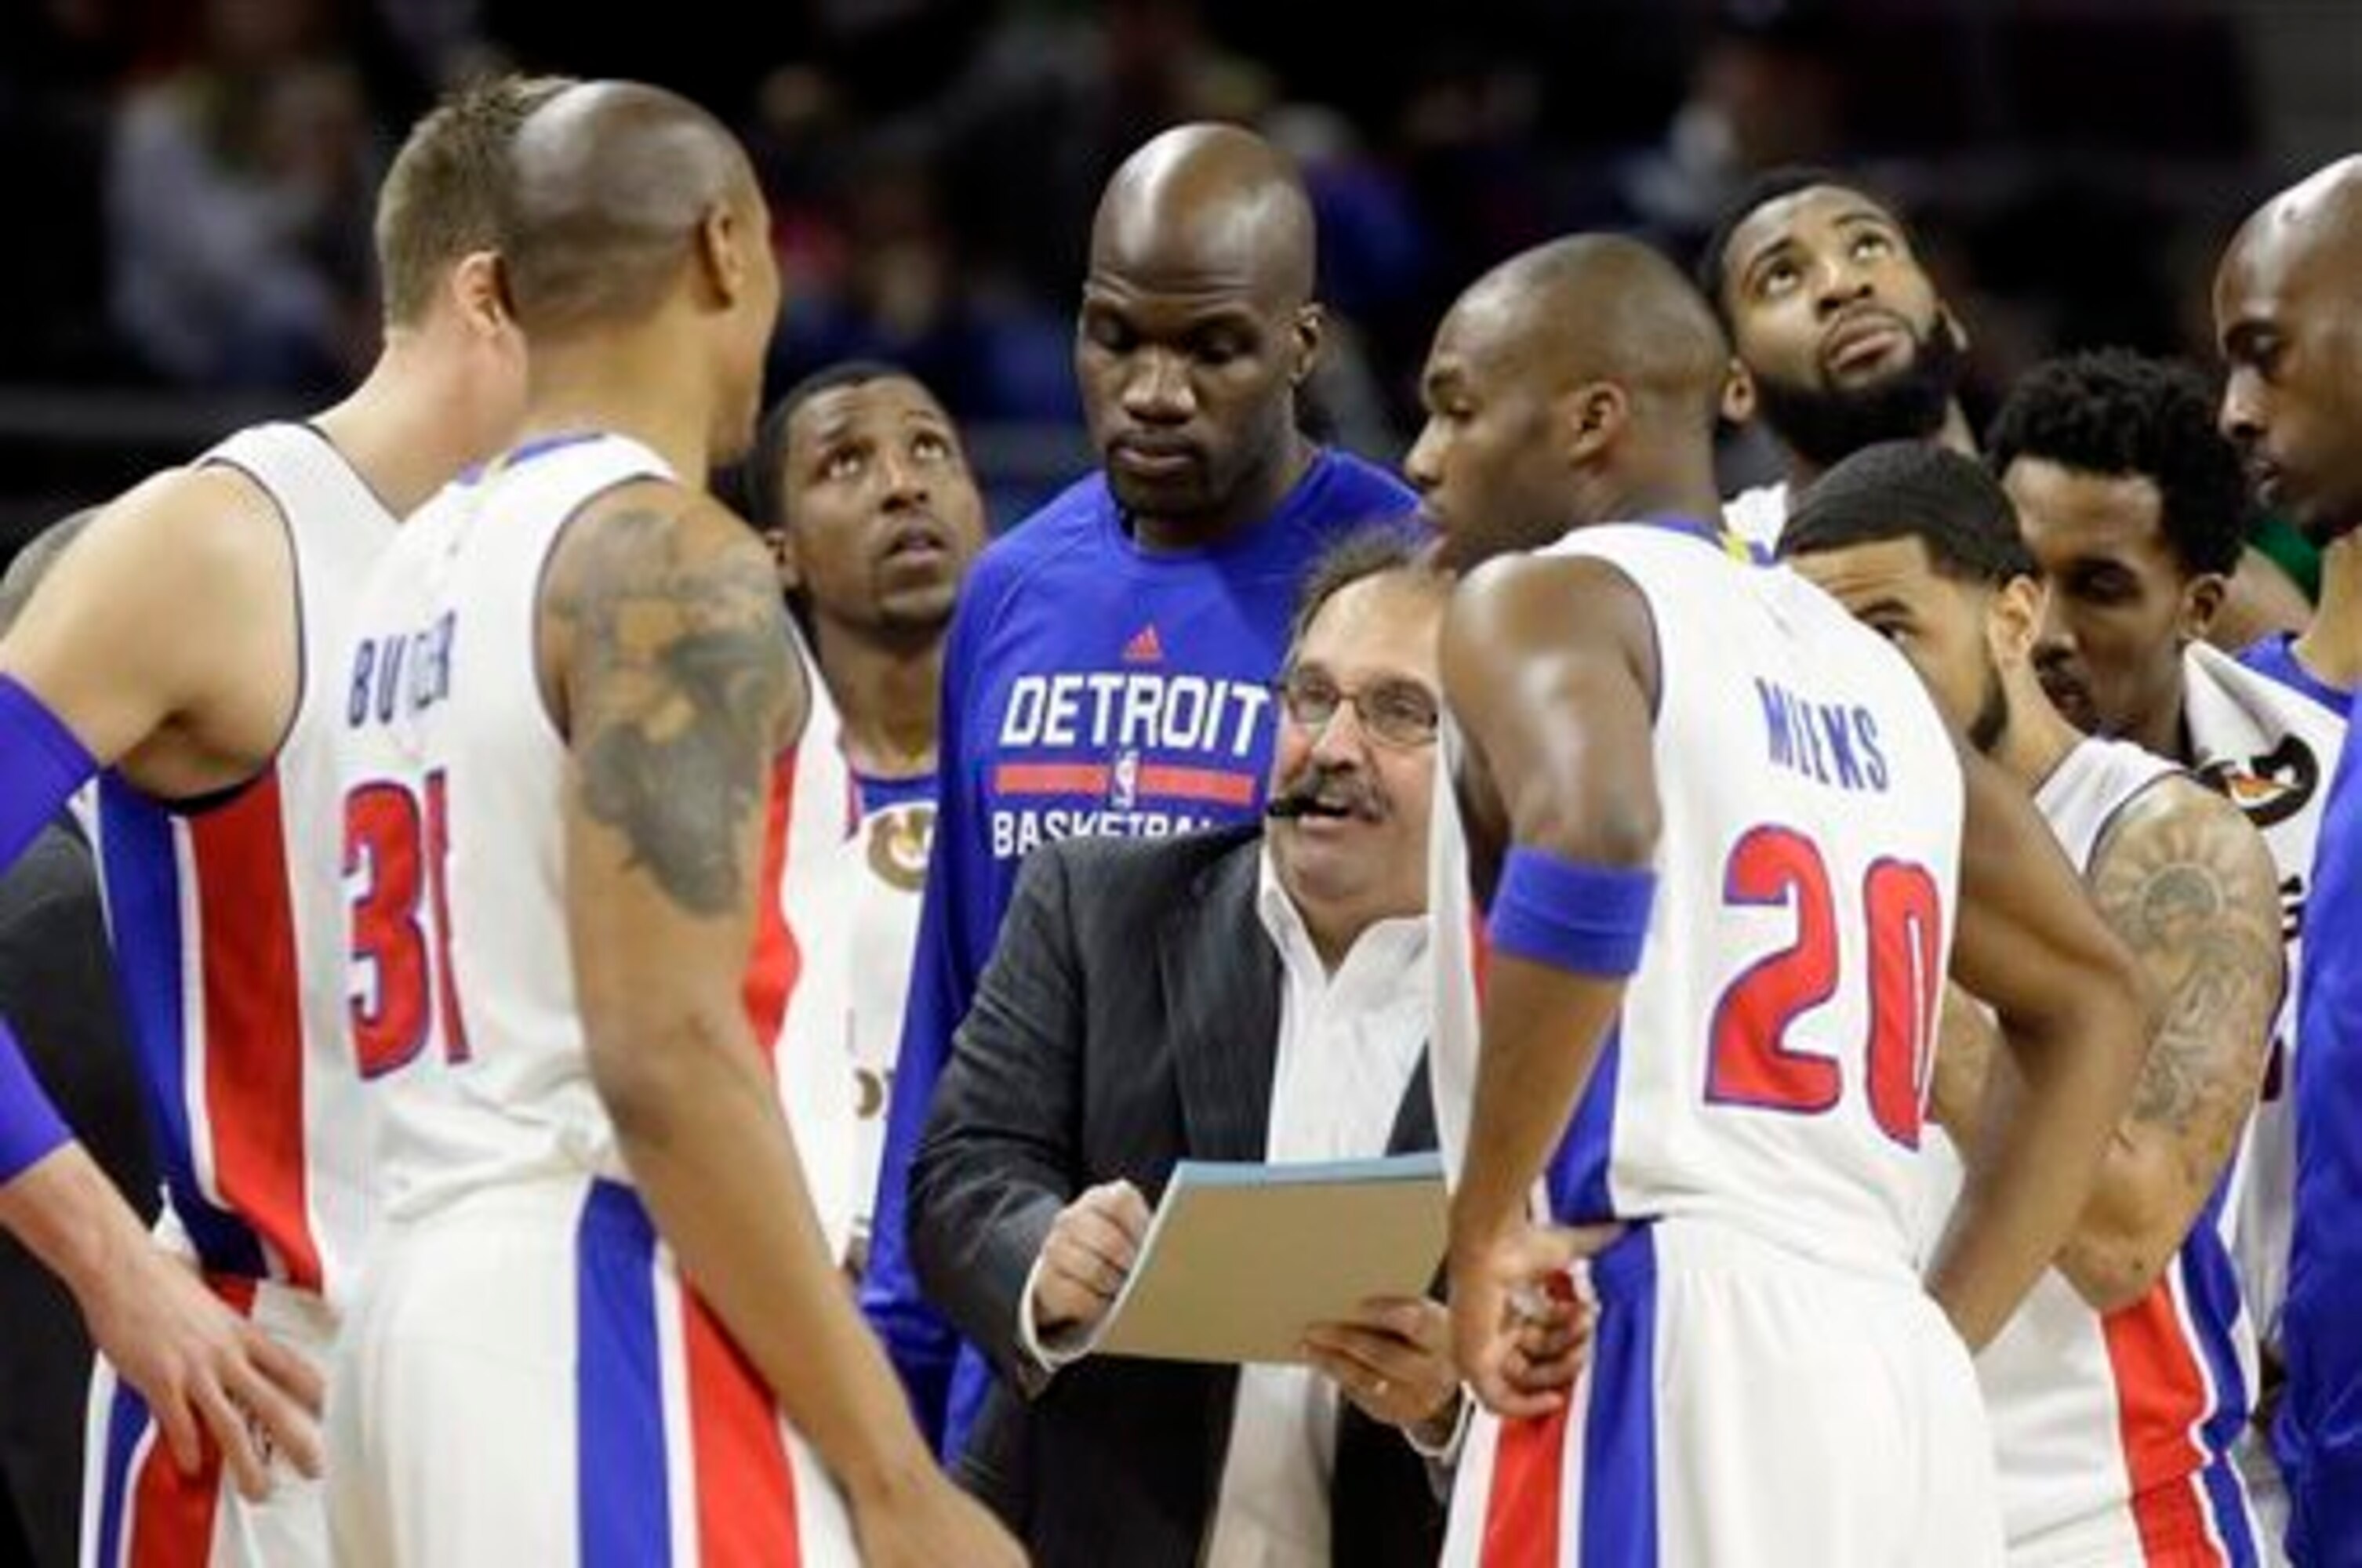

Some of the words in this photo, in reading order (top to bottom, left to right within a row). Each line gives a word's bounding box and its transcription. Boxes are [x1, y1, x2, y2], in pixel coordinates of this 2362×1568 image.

[999, 673, 1269, 756] DETROIT
[341, 768, 471, 1080] 31
[1703, 823, 1942, 1151] 20
